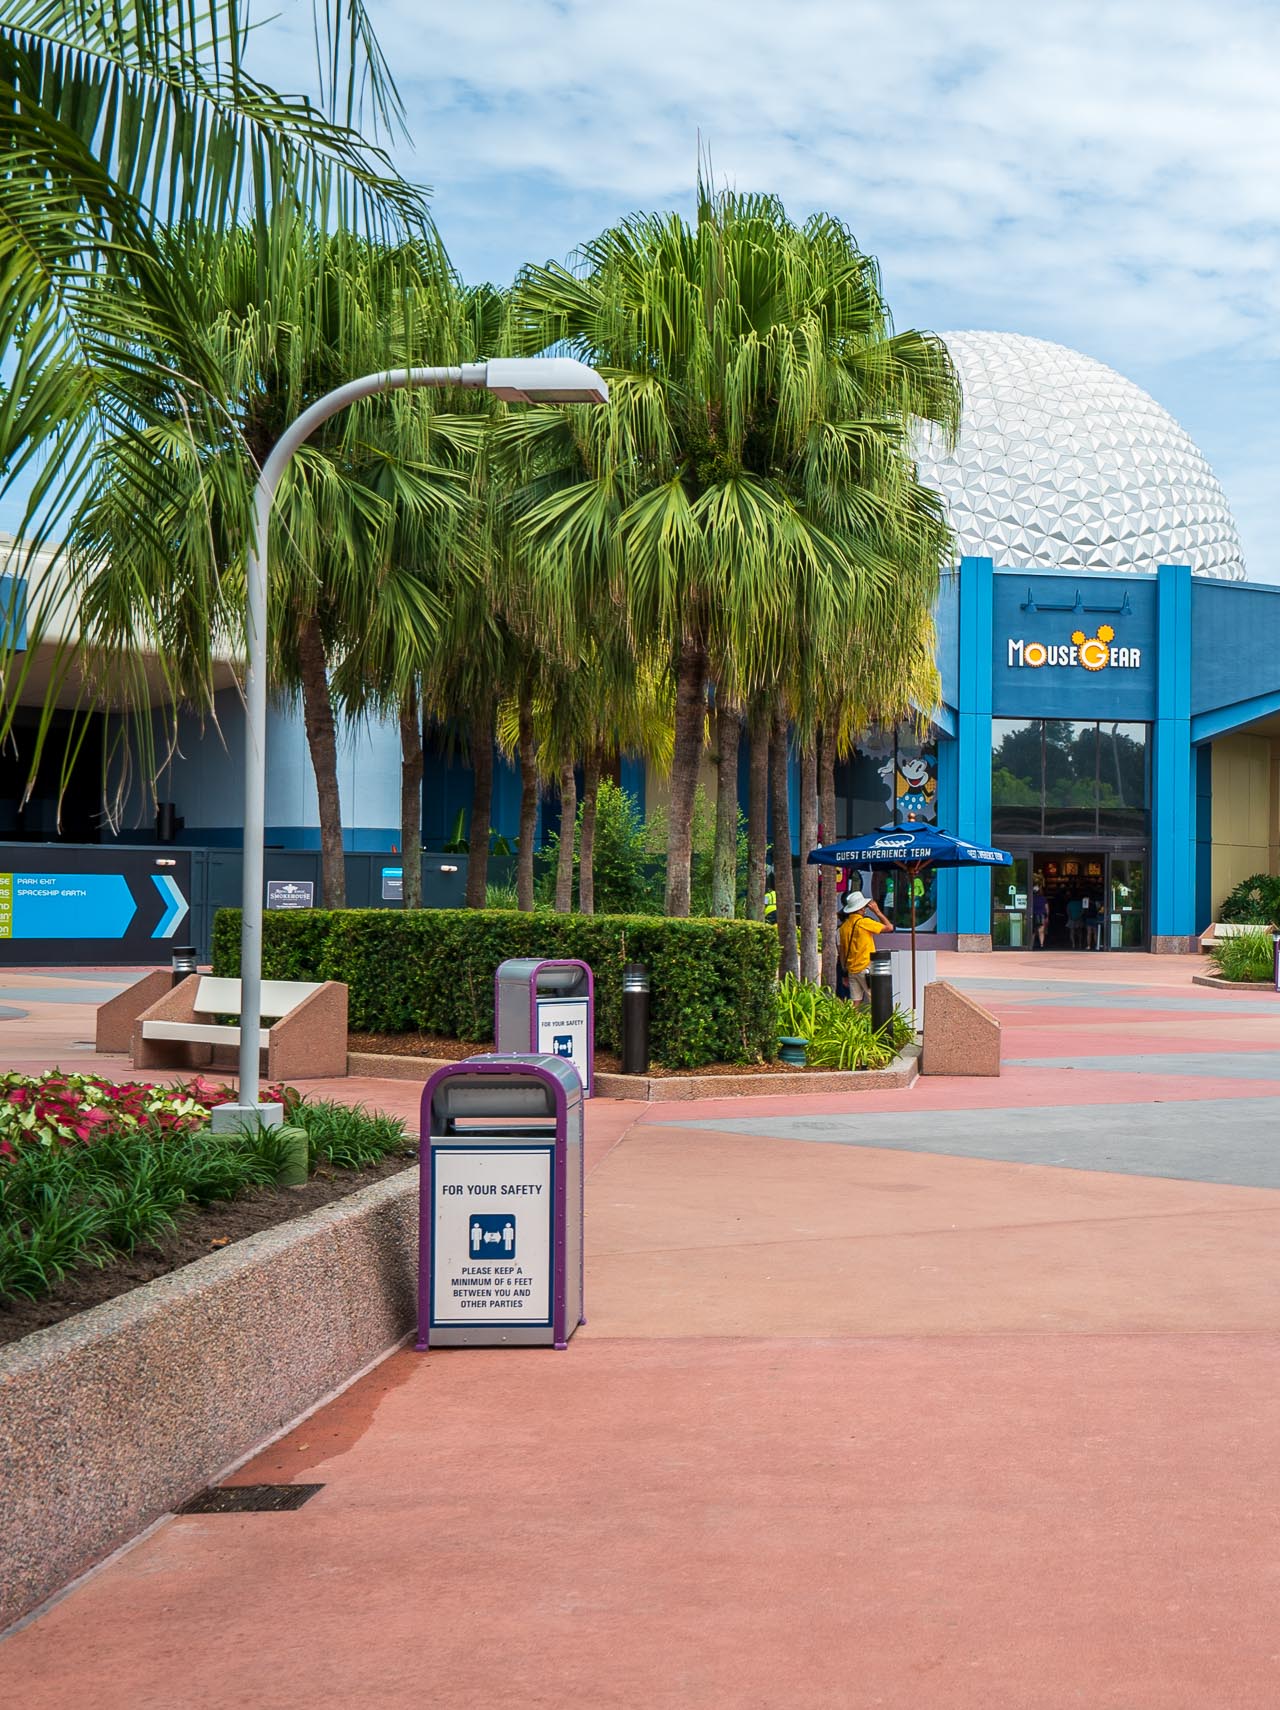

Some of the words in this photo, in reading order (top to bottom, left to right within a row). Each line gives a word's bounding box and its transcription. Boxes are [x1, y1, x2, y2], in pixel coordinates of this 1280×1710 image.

[836, 851, 859, 861] GUEST
[861, 849, 907, 860] EXPERIENCE
[910, 848, 931, 857] TEAM
[442, 1184, 464, 1196] FOR
[467, 1184, 497, 1196] YOUR
[500, 1184, 542, 1196] SAFETY
[462, 1267, 492, 1275] PLEASE
[494, 1266, 514, 1275] KEEP
[516, 1266, 523, 1275] A
[451, 1278, 492, 1286] MINIMUM
[494, 1278, 505, 1286] OF
[506, 1278, 512, 1286] 6
[514, 1278, 533, 1286] FEET
[453, 1289, 492, 1297] BETWEEN
[494, 1289, 511, 1297] YOU
[513, 1289, 531, 1297] AND
[460, 1300, 487, 1308] OTHER
[489, 1300, 523, 1308] PARTIES
